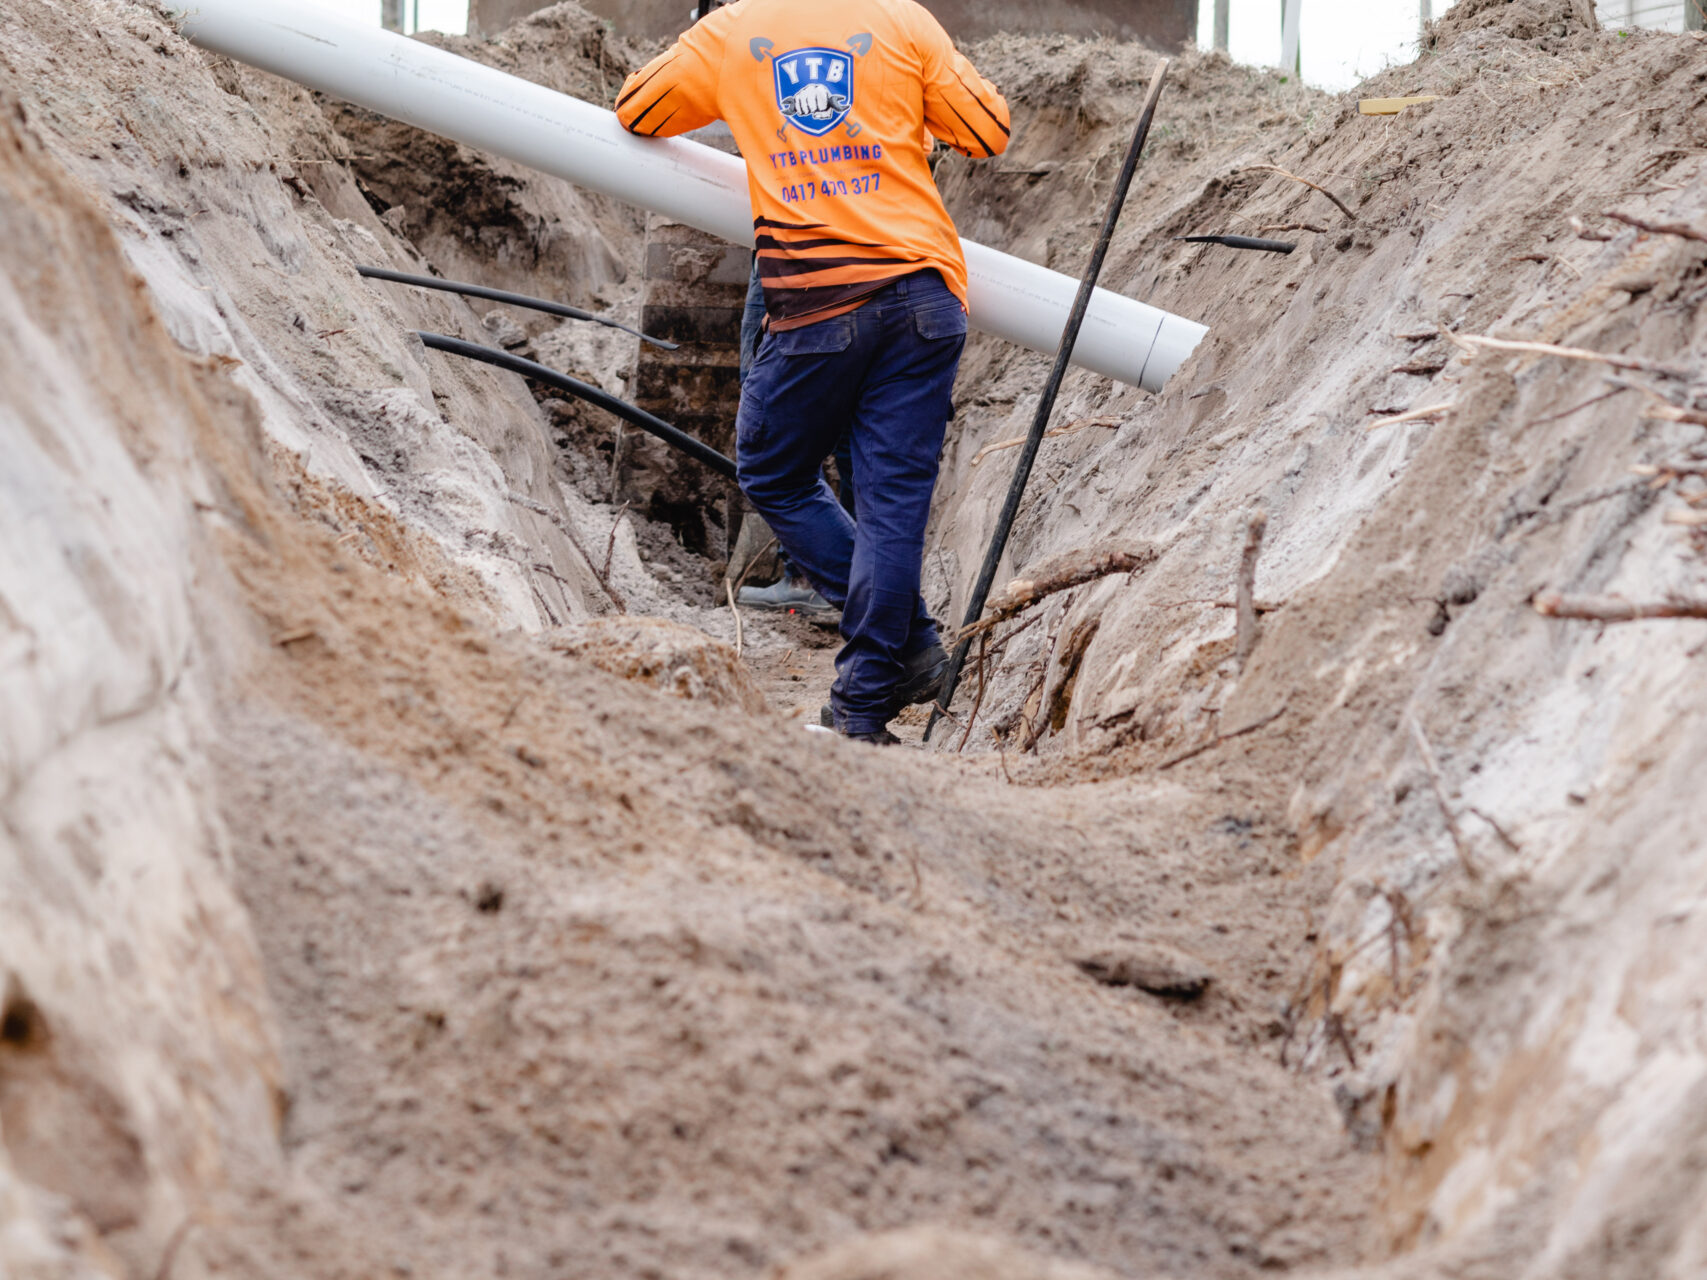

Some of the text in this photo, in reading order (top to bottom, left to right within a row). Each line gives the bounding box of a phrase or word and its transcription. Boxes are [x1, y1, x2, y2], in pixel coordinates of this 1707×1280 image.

[781, 56, 846, 84] YTB
[799, 144, 882, 165] PLUMBING
[782, 182, 816, 203] 0417
[851, 173, 880, 195] 377
